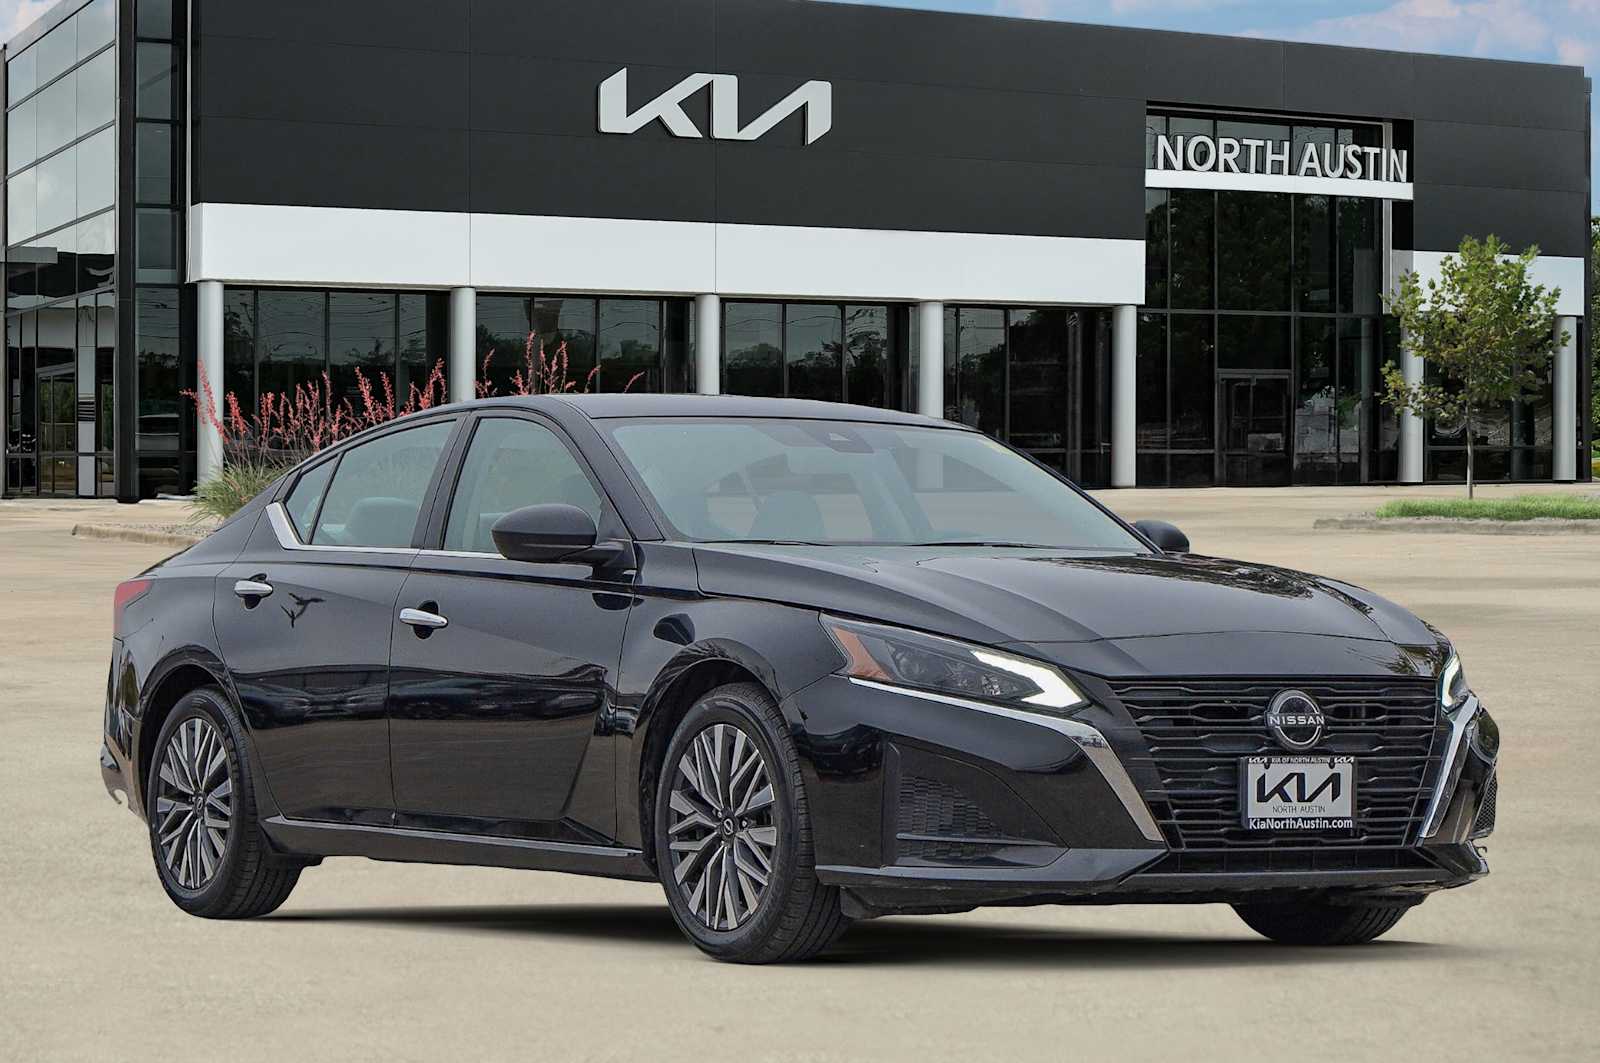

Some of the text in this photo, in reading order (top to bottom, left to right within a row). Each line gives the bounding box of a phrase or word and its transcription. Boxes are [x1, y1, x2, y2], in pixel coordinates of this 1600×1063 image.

[598, 67, 832, 146] KIA
[1156, 134, 1408, 183] NORTH AUSTIN
[1269, 715, 1325, 725] NISSAN
[1256, 772, 1341, 803] KIA
[1272, 805, 1326, 814] NORTH AUSTIN
[1249, 817, 1353, 830] KiaNorthAustin.com
